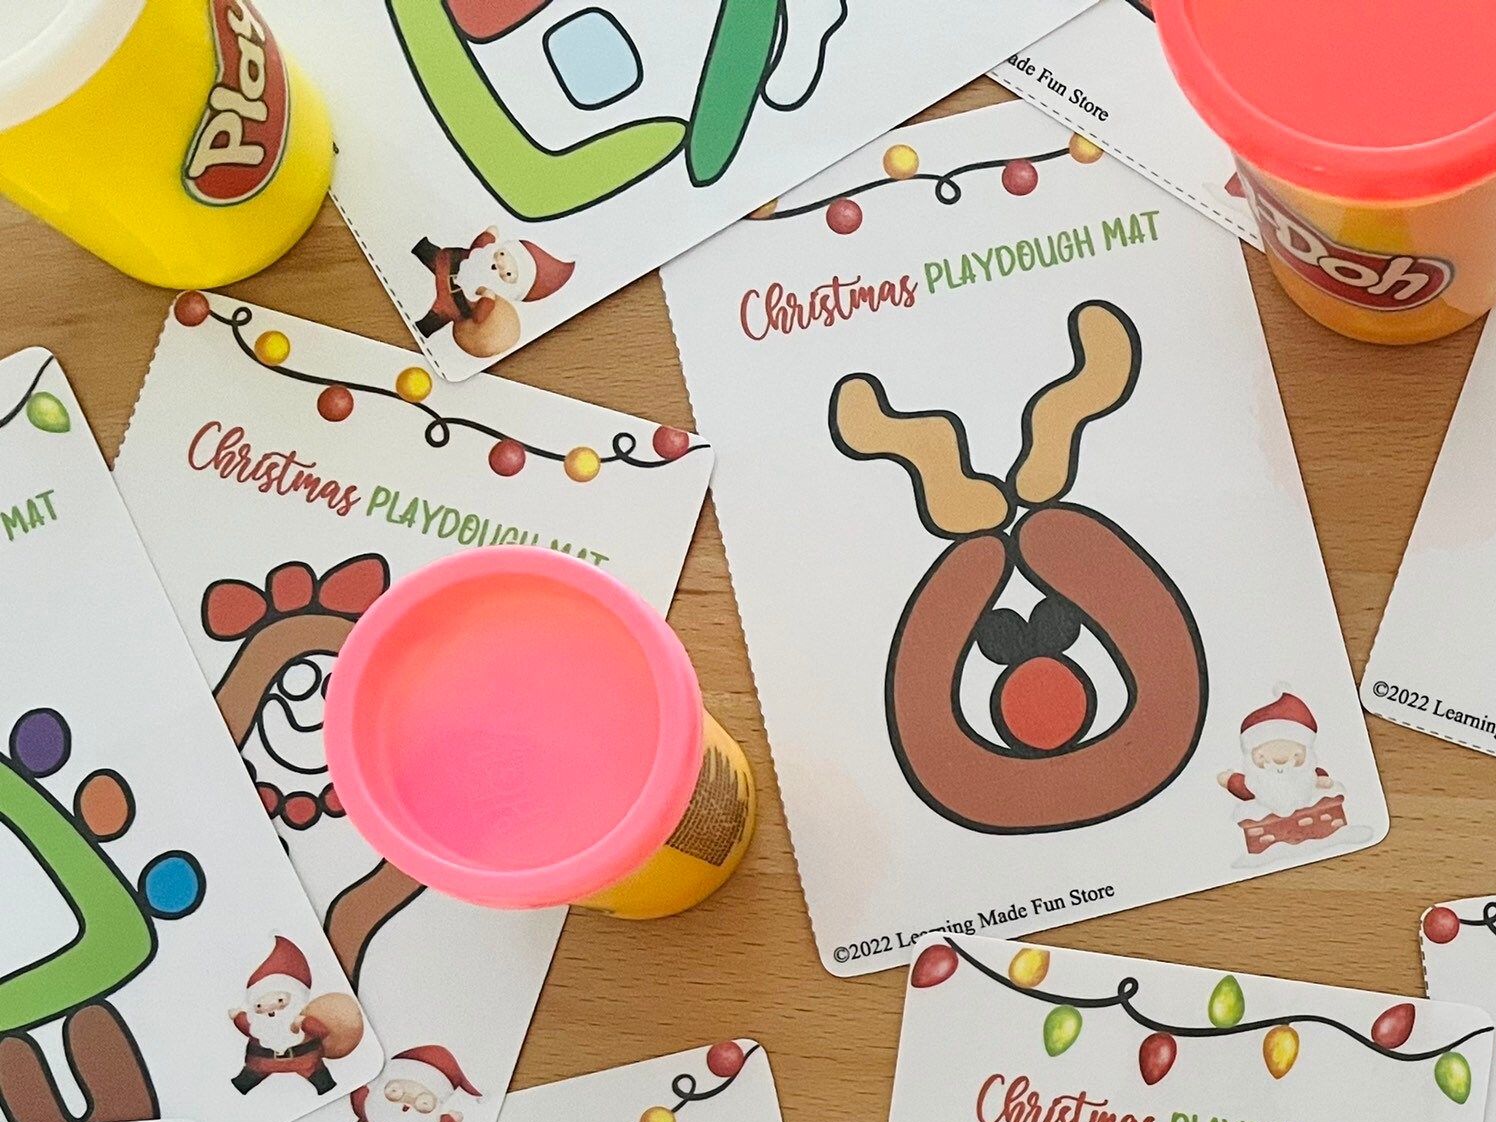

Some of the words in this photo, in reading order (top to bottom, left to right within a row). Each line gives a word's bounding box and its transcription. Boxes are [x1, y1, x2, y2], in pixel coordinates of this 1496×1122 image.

[1036, 67, 1068, 97] Fun
[1068, 88, 1110, 122] Store
[739, 273, 919, 341] Christmas
[923, 225, 1096, 295] PLAYDOUGH
[1102, 209, 1161, 251] MAT
[187, 420, 362, 517] Christmas
[0, 489, 57, 542] MAT
[1372, 680, 1431, 712] ©2022
[833, 936, 894, 963] ©2022
[976, 904, 1029, 930] Made
[1031, 896, 1067, 916] Fun
[1069, 884, 1116, 907] Store
